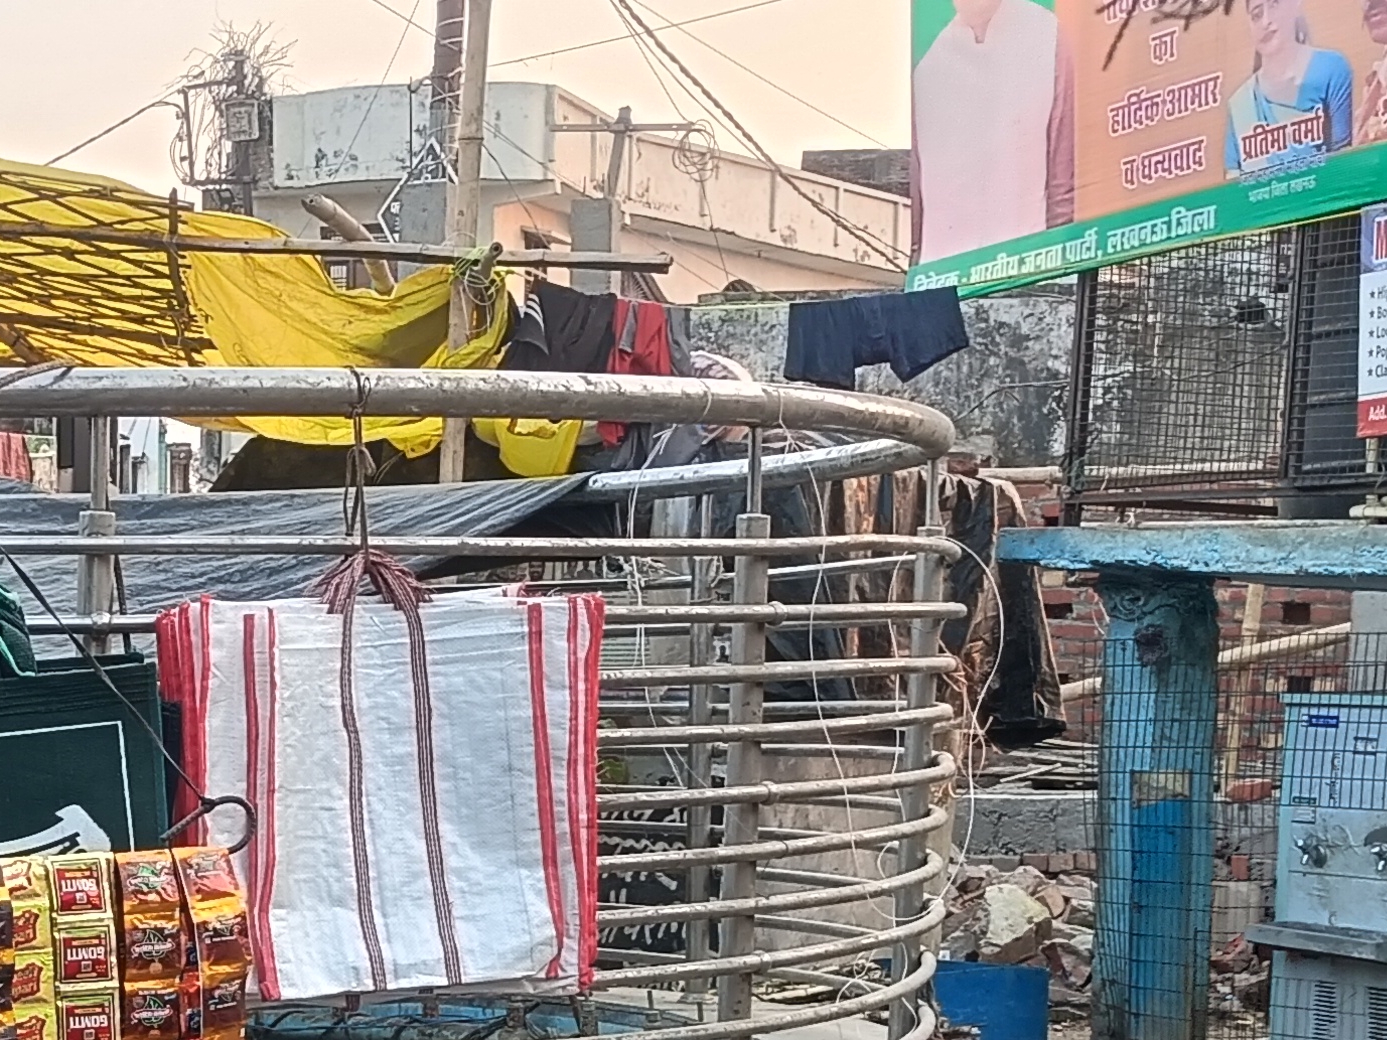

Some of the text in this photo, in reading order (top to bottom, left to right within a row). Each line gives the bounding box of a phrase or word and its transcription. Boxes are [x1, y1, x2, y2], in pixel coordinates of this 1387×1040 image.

[1151, 28, 1177, 63] का
[1108, 87, 1162, 136] हार्दिक
[1290, 105, 1324, 147] वर्मा
[969, 251, 1020, 285] भारतीय
[1021, 238, 1064, 274] जनता
[1106, 215, 1170, 255] लखनऊ
[1170, 205, 1218, 239] जिला
[61, 879, 98, 893] GOMTI
[66, 946, 106, 960] GOMTI
[69, 1014, 108, 1029] GOMTI
